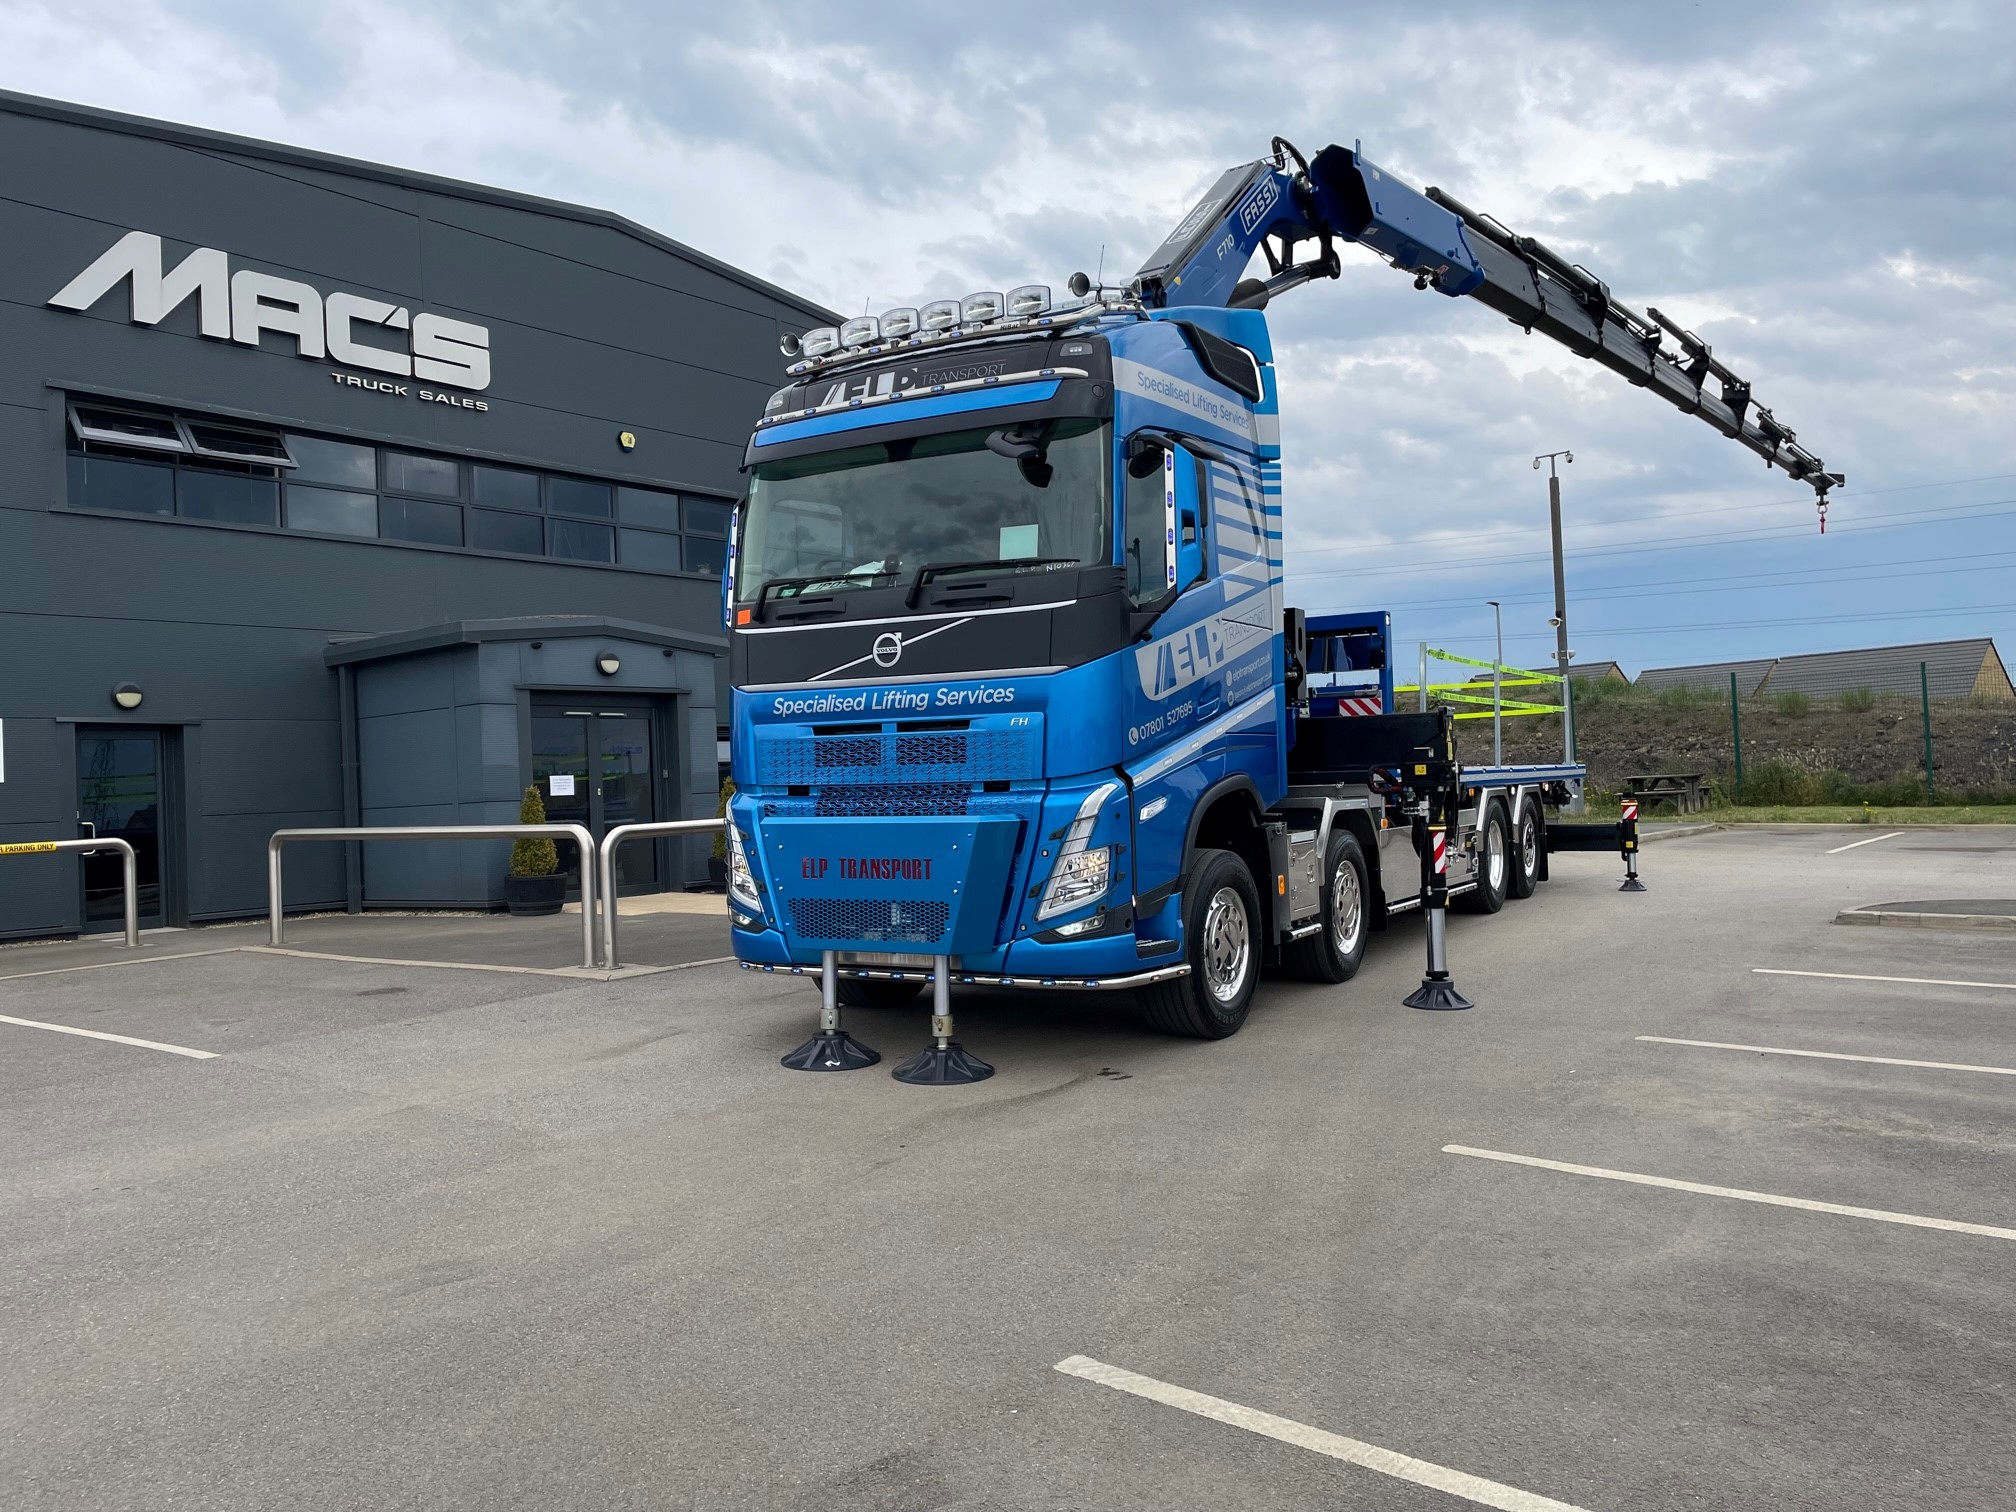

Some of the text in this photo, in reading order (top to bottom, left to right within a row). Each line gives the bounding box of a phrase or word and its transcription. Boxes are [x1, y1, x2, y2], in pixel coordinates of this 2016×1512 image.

[1244, 182, 1275, 227] FASSI
[1216, 234, 1235, 260] F710
[922, 363, 1007, 386] TRANSPORT
[331, 372, 489, 411] TRUCK SALES
[1137, 371, 1249, 430] Specialised Lifting Services
[773, 685, 1015, 717] Specialised Lifting Services
[1010, 717, 1029, 726] FH
[1139, 701, 1193, 740] 07801 527695
[6, 844, 35, 852] PARKING
[38, 843, 54, 851] ONLY
[801, 858, 932, 880] ELP TRANSPORT
